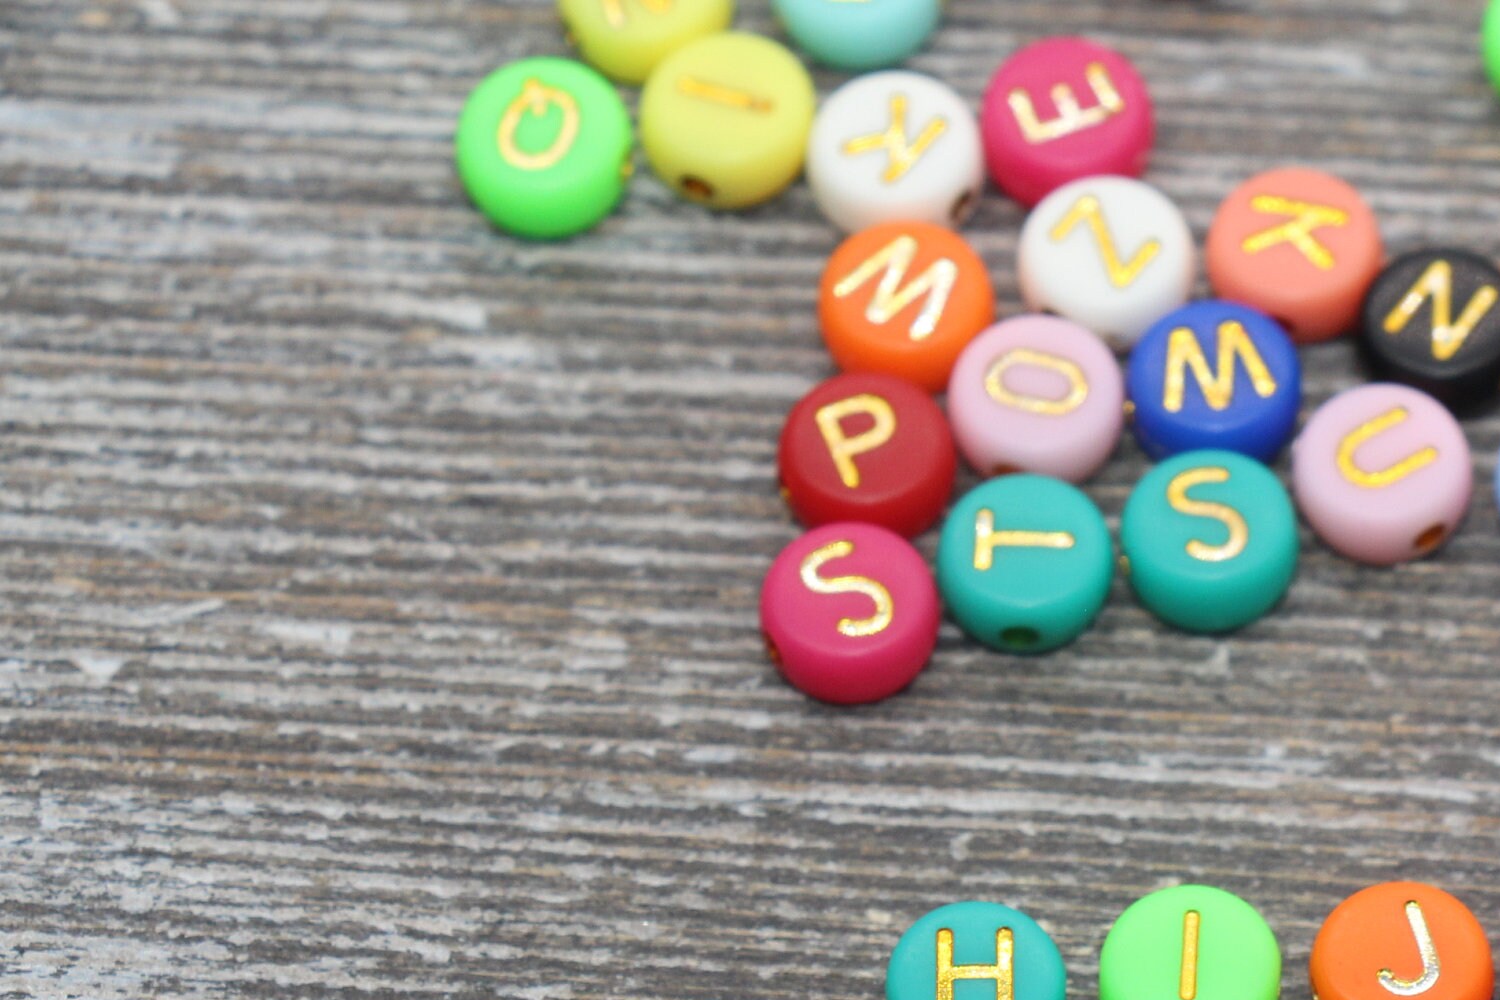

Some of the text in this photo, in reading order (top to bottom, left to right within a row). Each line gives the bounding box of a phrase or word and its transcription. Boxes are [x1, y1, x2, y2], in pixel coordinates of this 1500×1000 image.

[497, 76, 580, 170] Q
[676, 74, 775, 116] I
[1007, 61, 1126, 144] E
[1243, 194, 1348, 270] K
[1384, 260, 1499, 360] N
[815, 393, 896, 489] P
[1337, 406, 1438, 489] U
[973, 508, 1075, 571] T
[1166, 466, 1249, 562] S
[801, 540, 894, 638] S
[1178, 909, 1200, 1000] I
[1376, 900, 1440, 996] J
